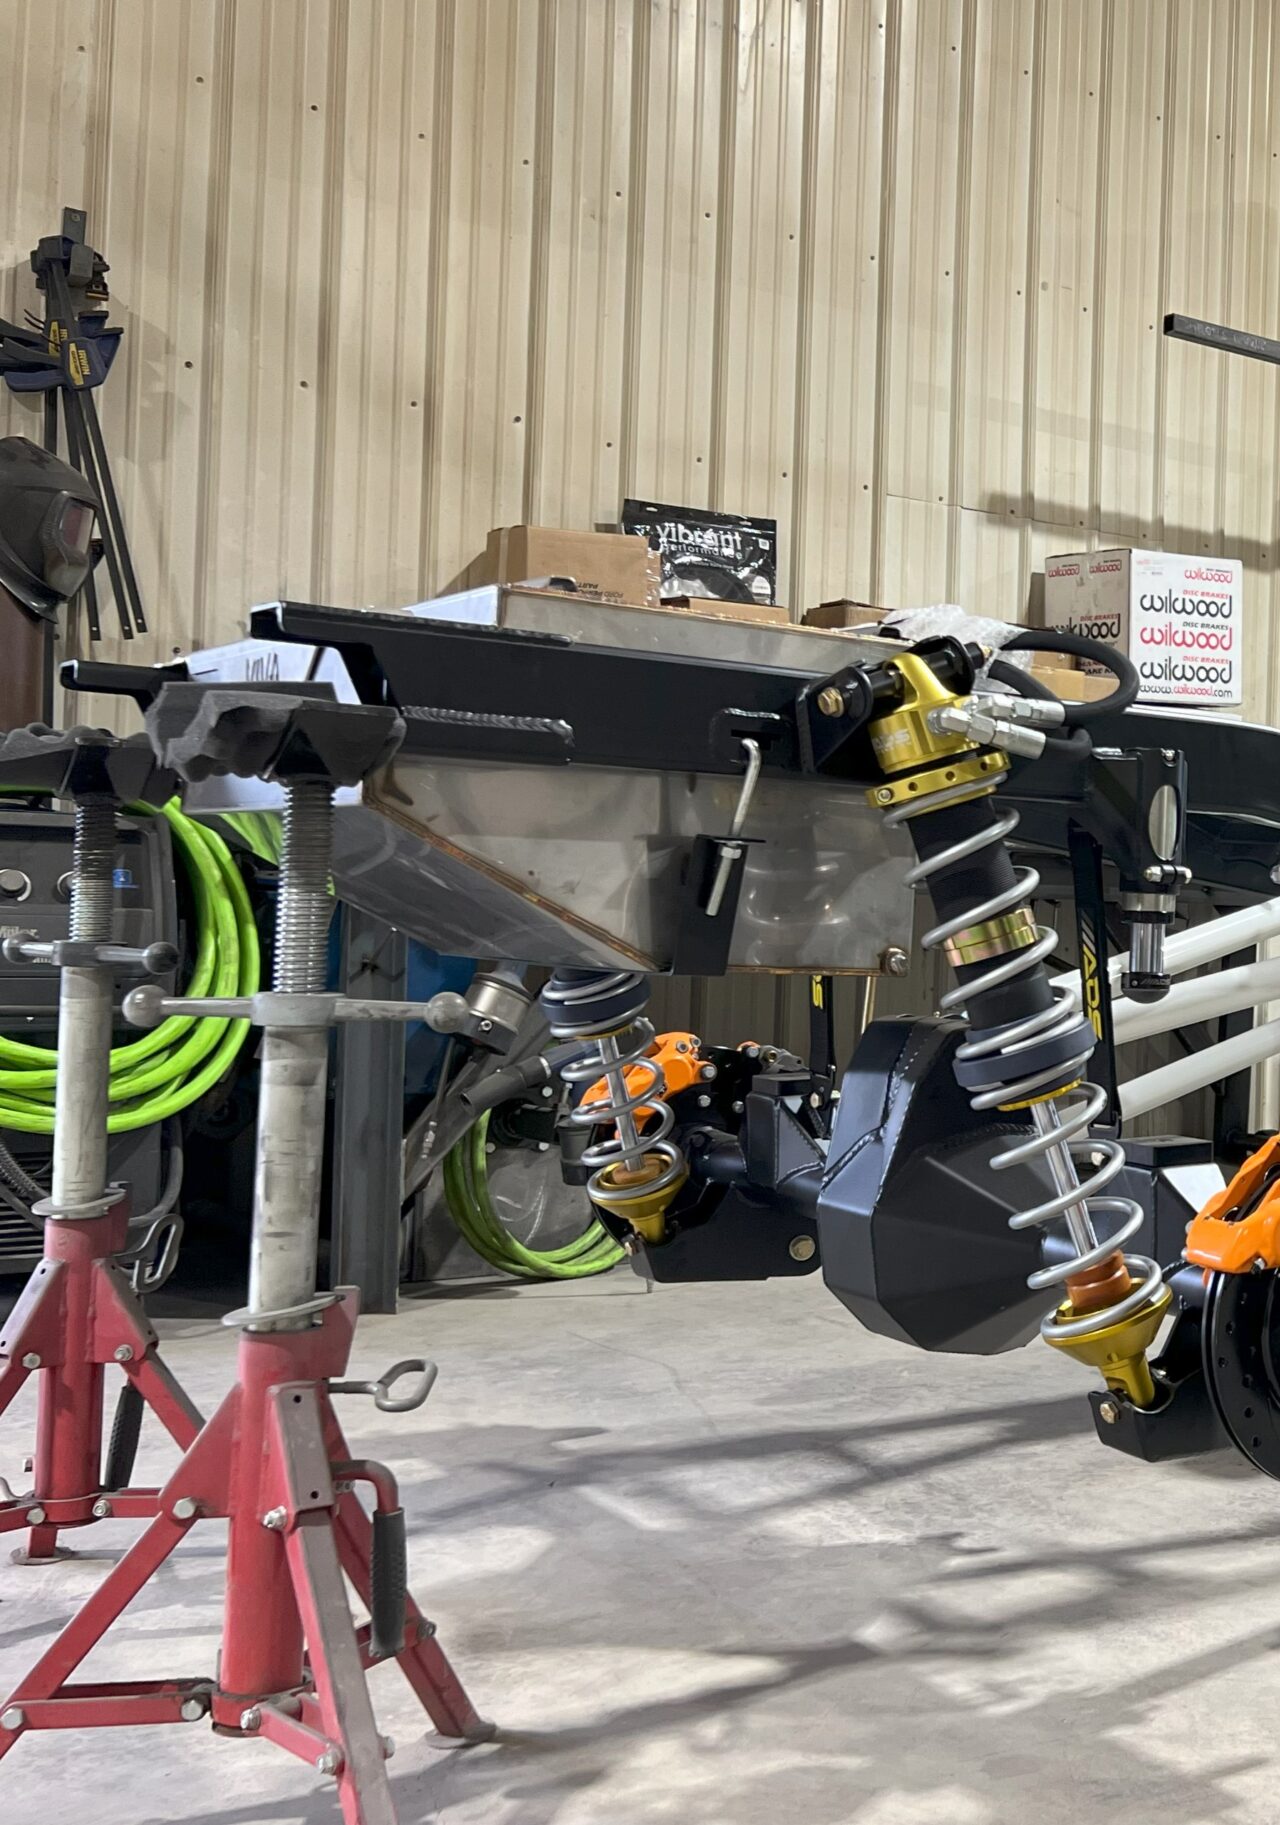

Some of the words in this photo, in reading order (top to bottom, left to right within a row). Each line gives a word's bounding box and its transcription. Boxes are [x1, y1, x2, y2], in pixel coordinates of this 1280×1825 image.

[78, 349, 91, 375] IRWIN
[656, 522, 742, 550] vibrant
[1183, 568, 1233, 584] wilwood
[1140, 588, 1232, 618] wilwood
[1182, 589, 1199, 597] DISC
[1200, 590, 1229, 600] BRAKES
[1140, 621, 1232, 651] wilwood
[1200, 622, 1229, 631] BRAKES
[1140, 656, 1232, 684] wilwood
[1182, 655, 1199, 663] DISC
[1200, 656, 1229, 665] BRAKES
[1139, 684, 1233, 698] www.wilwood.com
